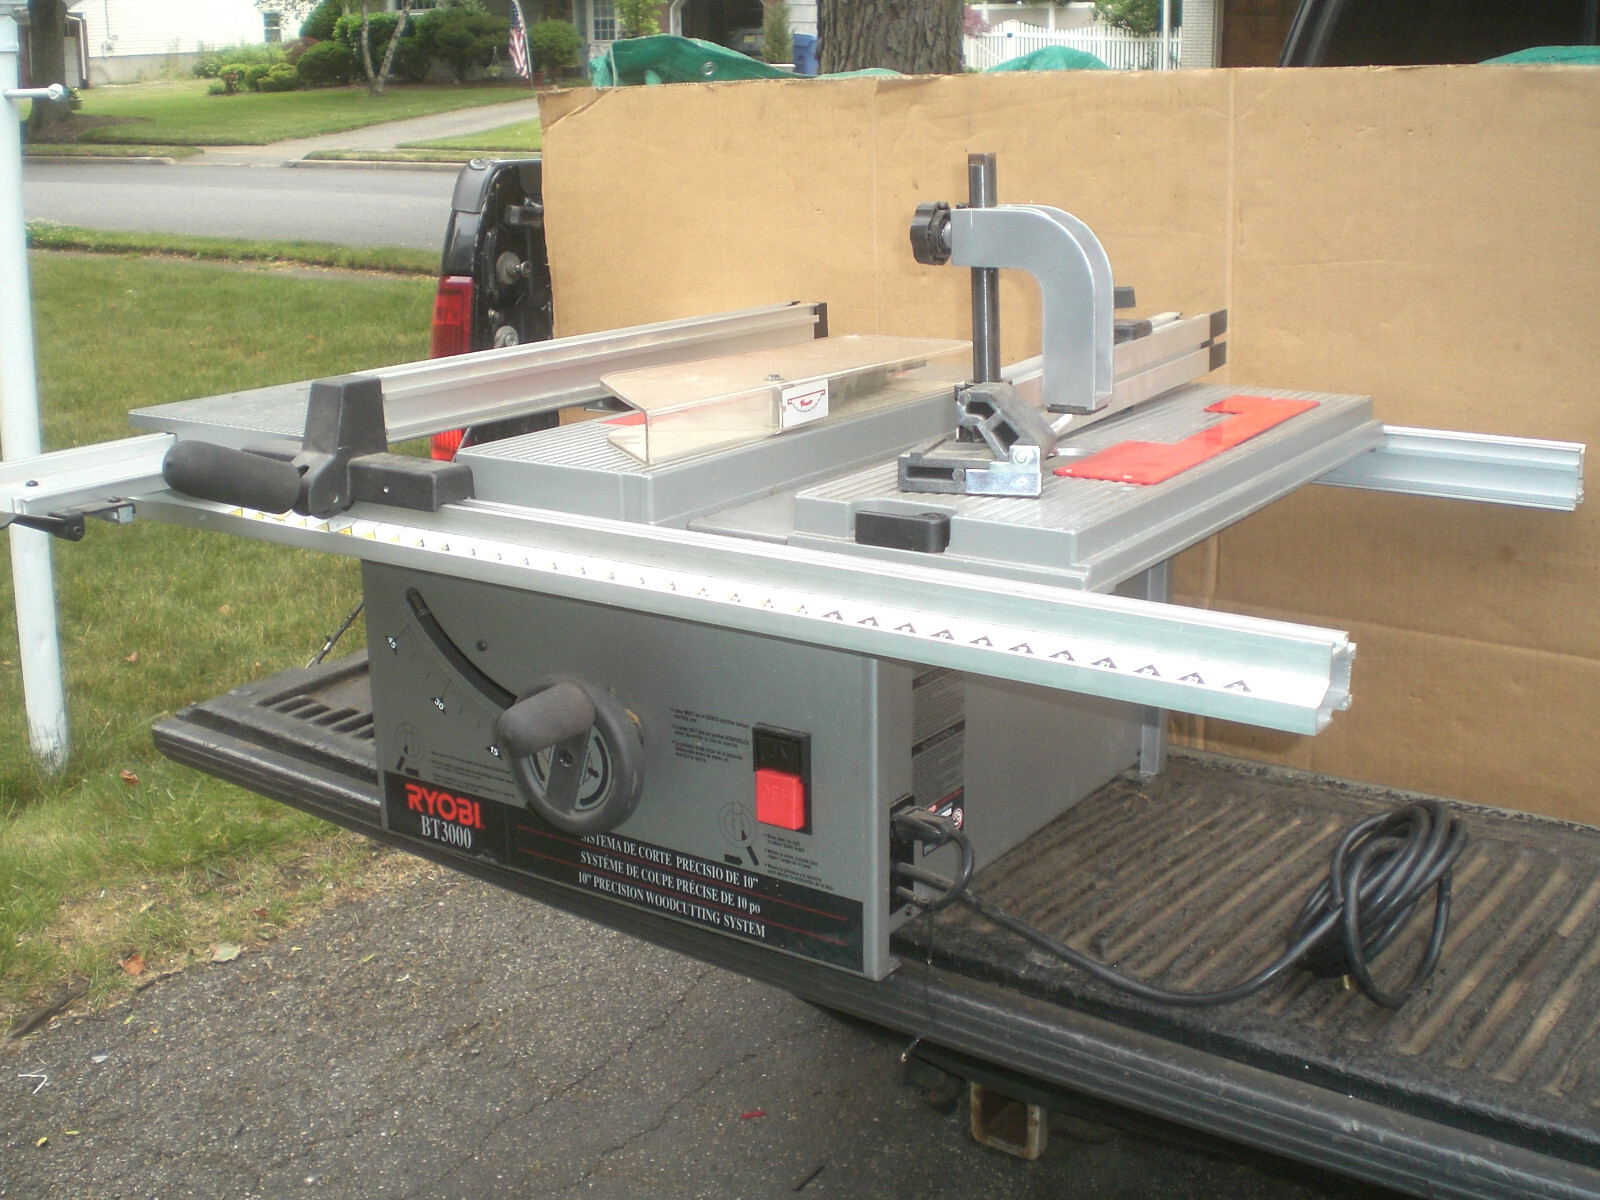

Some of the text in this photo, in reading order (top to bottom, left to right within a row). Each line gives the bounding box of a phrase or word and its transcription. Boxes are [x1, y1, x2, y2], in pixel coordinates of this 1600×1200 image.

[434, 698, 444, 710] 30
[490, 746, 499, 756] 15
[405, 783, 482, 829] RYOBI
[420, 815, 472, 849] BT3000
[623, 841, 637, 857] DE
[638, 845, 672, 867] CORTE
[676, 855, 724, 882] PRECISIO
[725, 869, 740, 886] DE
[593, 875, 644, 902] PRECISION
[645, 891, 720, 924] WOODCUTTING
[723, 914, 766, 938] SYSTEM
[626, 863, 640, 879] DE
[641, 868, 675, 889] COUPE
[676, 878, 719, 902] PRÉCISE
[720, 890, 735, 907] DE
[737, 895, 748, 910] 10
[749, 902, 761, 915] po
